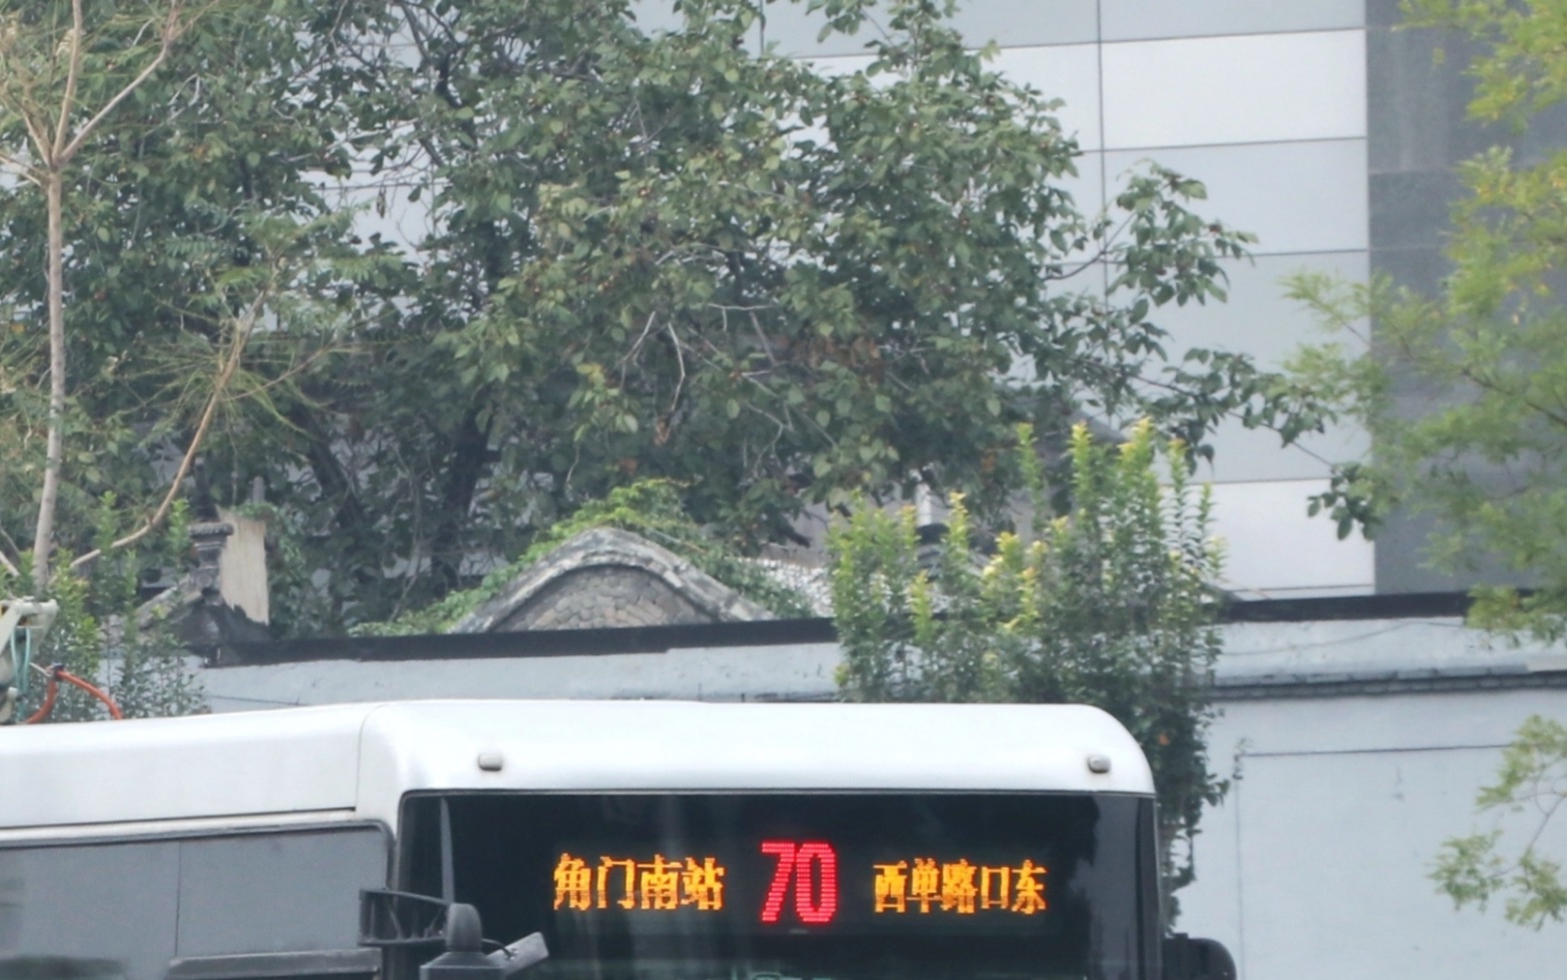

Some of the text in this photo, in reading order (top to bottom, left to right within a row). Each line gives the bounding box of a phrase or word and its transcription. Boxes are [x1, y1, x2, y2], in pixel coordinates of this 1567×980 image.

[553, 842, 1047, 923] 角门南站 70 西单路口东
